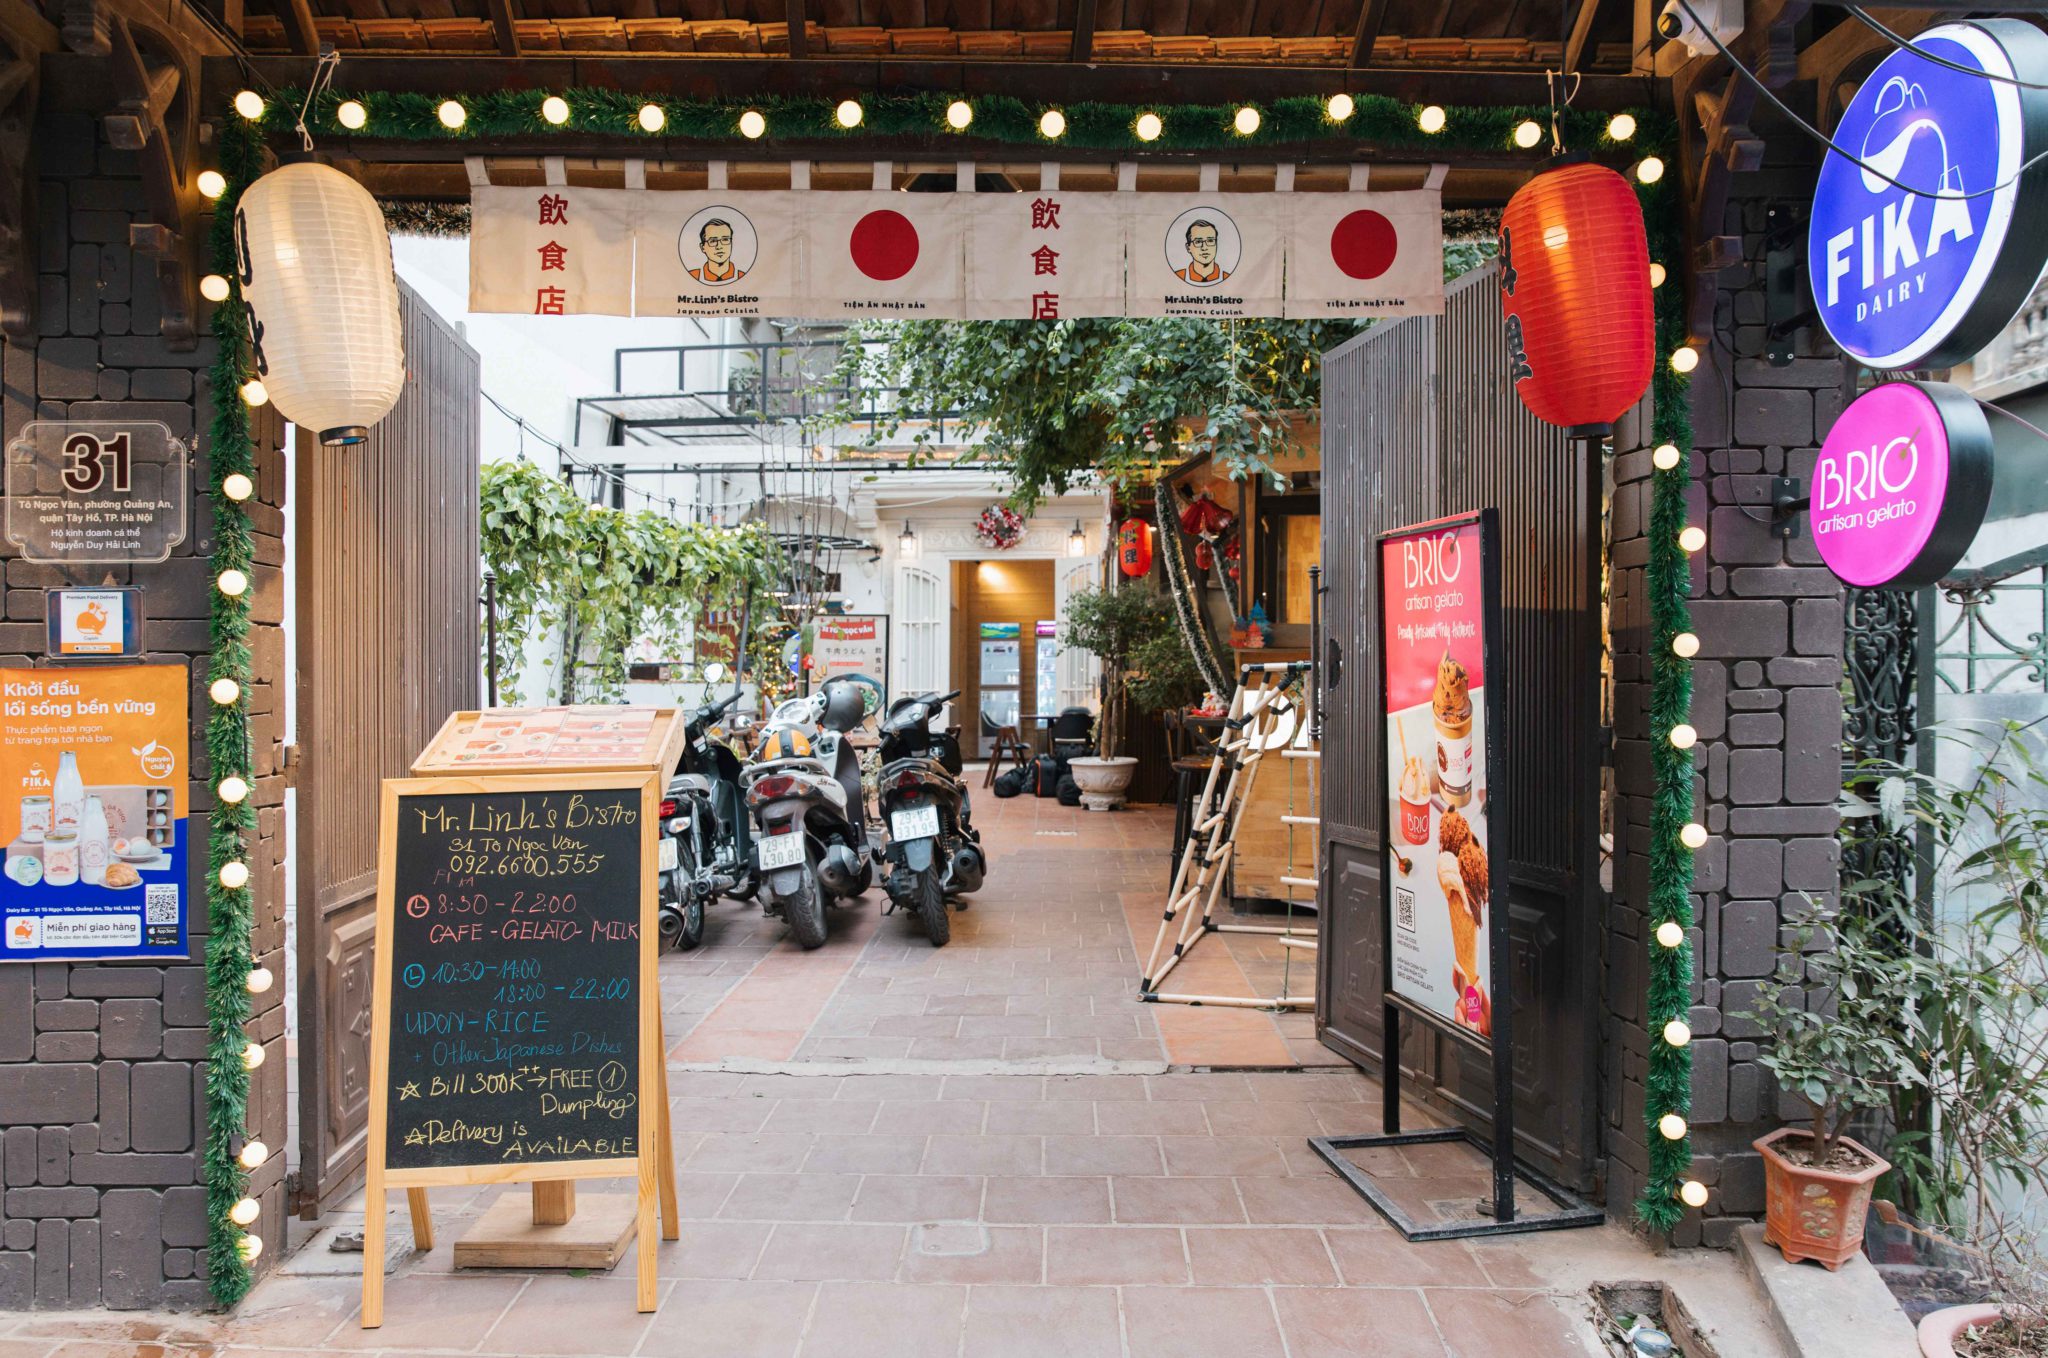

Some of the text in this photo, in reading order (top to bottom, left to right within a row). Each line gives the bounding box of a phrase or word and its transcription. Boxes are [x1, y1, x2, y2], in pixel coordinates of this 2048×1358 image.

[535, 193, 568, 315] 飲食店
[1030, 198, 1060, 320] 飲食店
[1827, 190, 1974, 308] FIKA
[727, 294, 759, 303] Bistro
[1212, 295, 1243, 304] Bistro
[1856, 272, 1926, 322] DAIRY
[61, 432, 131, 493] 31
[1820, 436, 1918, 511] BRIO
[34, 500, 58, 510] Ngọc
[123, 499, 155, 510] Quảng
[157, 500, 174, 509] An,
[1818, 498, 1916, 534] artisan gelato
[39, 513, 63, 523] quận
[66, 513, 83, 523] Tây
[105, 514, 119, 522] TP.
[121, 513, 134, 522] Hà
[136, 513, 153, 523] Nội
[65, 528, 84, 537] kinh
[85, 529, 112, 537] doanh
[114, 528, 125, 537] cá
[86, 541, 103, 551] Duy
[122, 540, 141, 549] Linh
[1404, 532, 1461, 589] BRIO
[1405, 589, 1464, 612] artisan gelato
[4, 680, 80, 697] Khởi đầu
[5, 698, 156, 717] lối sống bền vững
[5, 725, 28, 735] Thực
[30, 724, 57, 736] phẩm
[79, 725, 103, 735] ngon
[18, 737, 42, 746] trang
[95, 735, 113, 745] bạn
[22, 777, 51, 787] FIKA
[414, 794, 637, 834] Mr. Linh's Bistro
[1407, 813, 1429, 832] BRIO
[448, 838, 477, 853] 31
[765, 835, 796, 853] 29-F1
[450, 854, 605, 877] 092.6600.555
[763, 847, 802, 867] 430.80
[438, 894, 488, 915] 8:30
[511, 891, 577, 914] 22:00
[47, 922, 136, 933] Miễn phí giao hàng
[429, 923, 484, 944] CAFE
[591, 920, 639, 943] MILK
[494, 982, 546, 1003] 18:00
[569, 978, 630, 1000] 22:00
[433, 1038, 480, 1066] Other
[483, 1037, 565, 1068] Japanese
[430, 1074, 465, 1096] Bill
[550, 1068, 594, 1090] FREE
[541, 1092, 636, 1120] Dumpling
[423, 1119, 527, 1146] Delivery is
